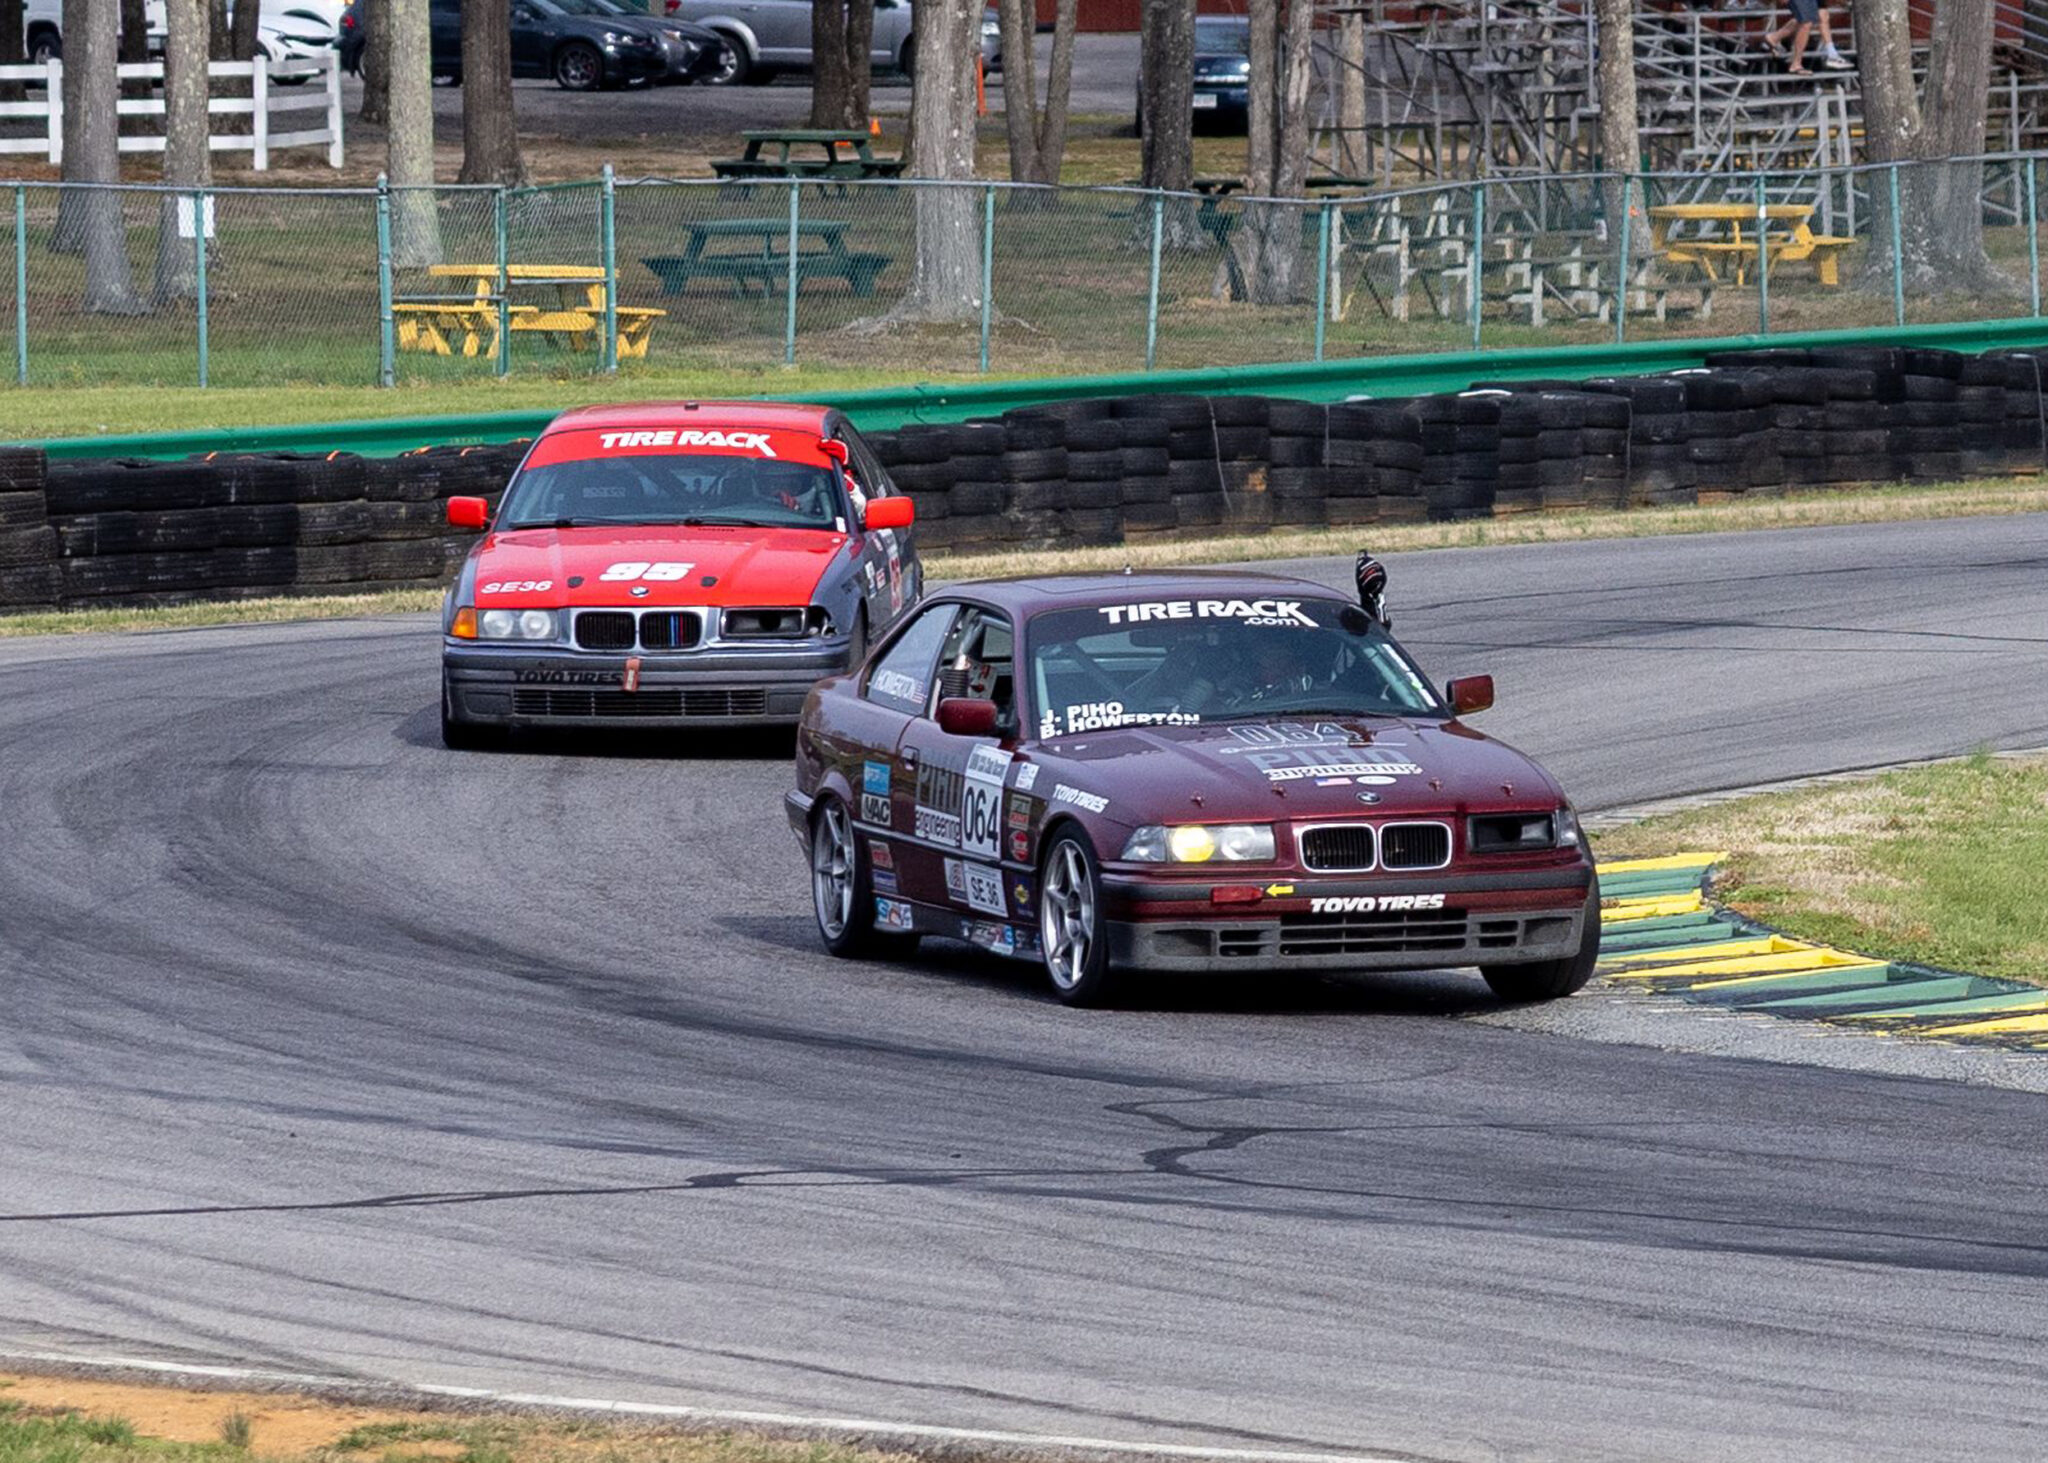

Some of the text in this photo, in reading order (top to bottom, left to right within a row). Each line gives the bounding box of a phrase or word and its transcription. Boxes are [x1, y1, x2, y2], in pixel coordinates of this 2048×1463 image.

[600, 431, 777, 457] TIRE RACK
[599, 562, 696, 582] 95
[481, 580, 554, 595] SE36
[1099, 600, 1319, 628] TIRE RACK
[1244, 617, 1300, 627] .com
[513, 670, 624, 685] TOYO TIRES
[1040, 702, 1124, 725] J. PIHO
[1040, 723, 1063, 740] B.
[1053, 783, 1079, 804] TOYO
[1075, 790, 1110, 813] TIRES
[963, 785, 999, 853] 064
[1310, 894, 1446, 913] TOYO TIRES
